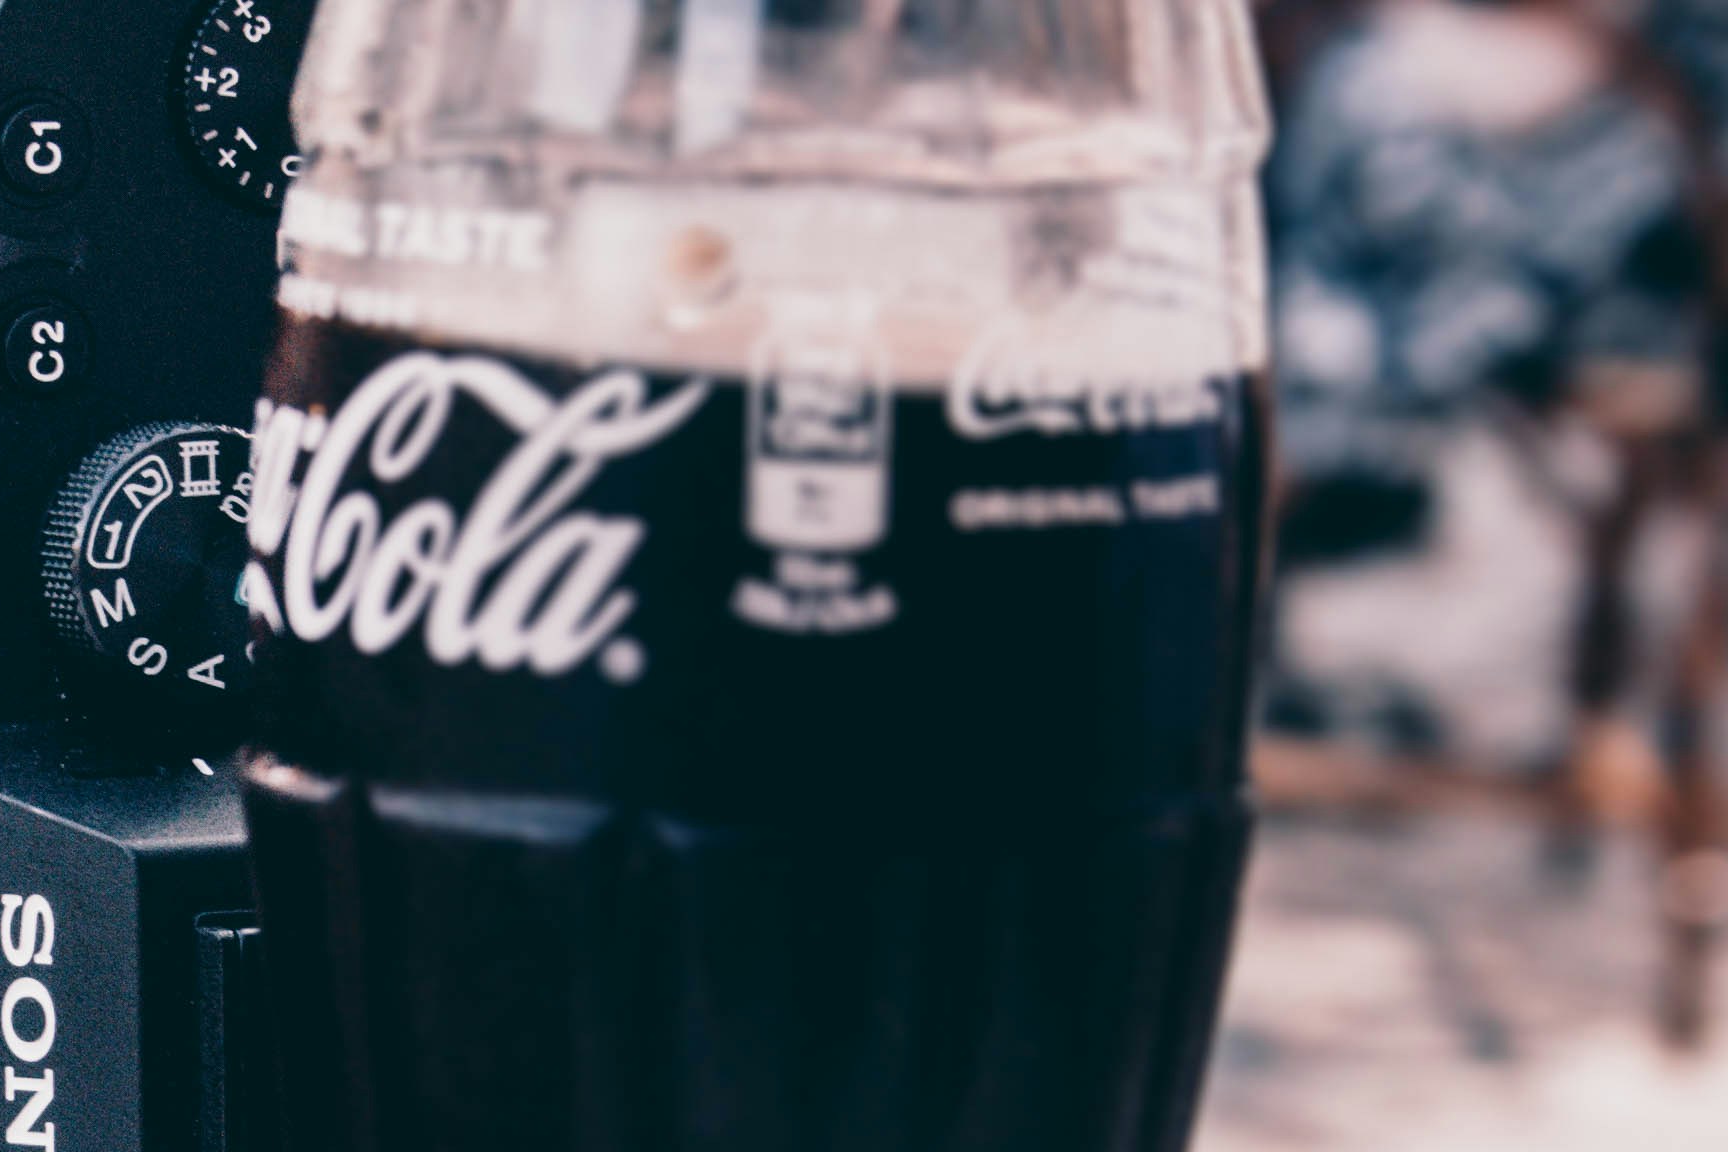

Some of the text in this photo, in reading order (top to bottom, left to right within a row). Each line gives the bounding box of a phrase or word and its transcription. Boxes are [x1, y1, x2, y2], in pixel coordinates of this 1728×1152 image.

[193, 67, 239, 97] +2
[25, 120, 62, 174] C1
[218, 126, 257, 168] +1
[28, 320, 65, 382] C2
[123, 468, 164, 509] 2
[102, 520, 124, 560] 1
[89, 577, 136, 628] M
[127, 637, 168, 675] S
[187, 654, 225, 689] A
